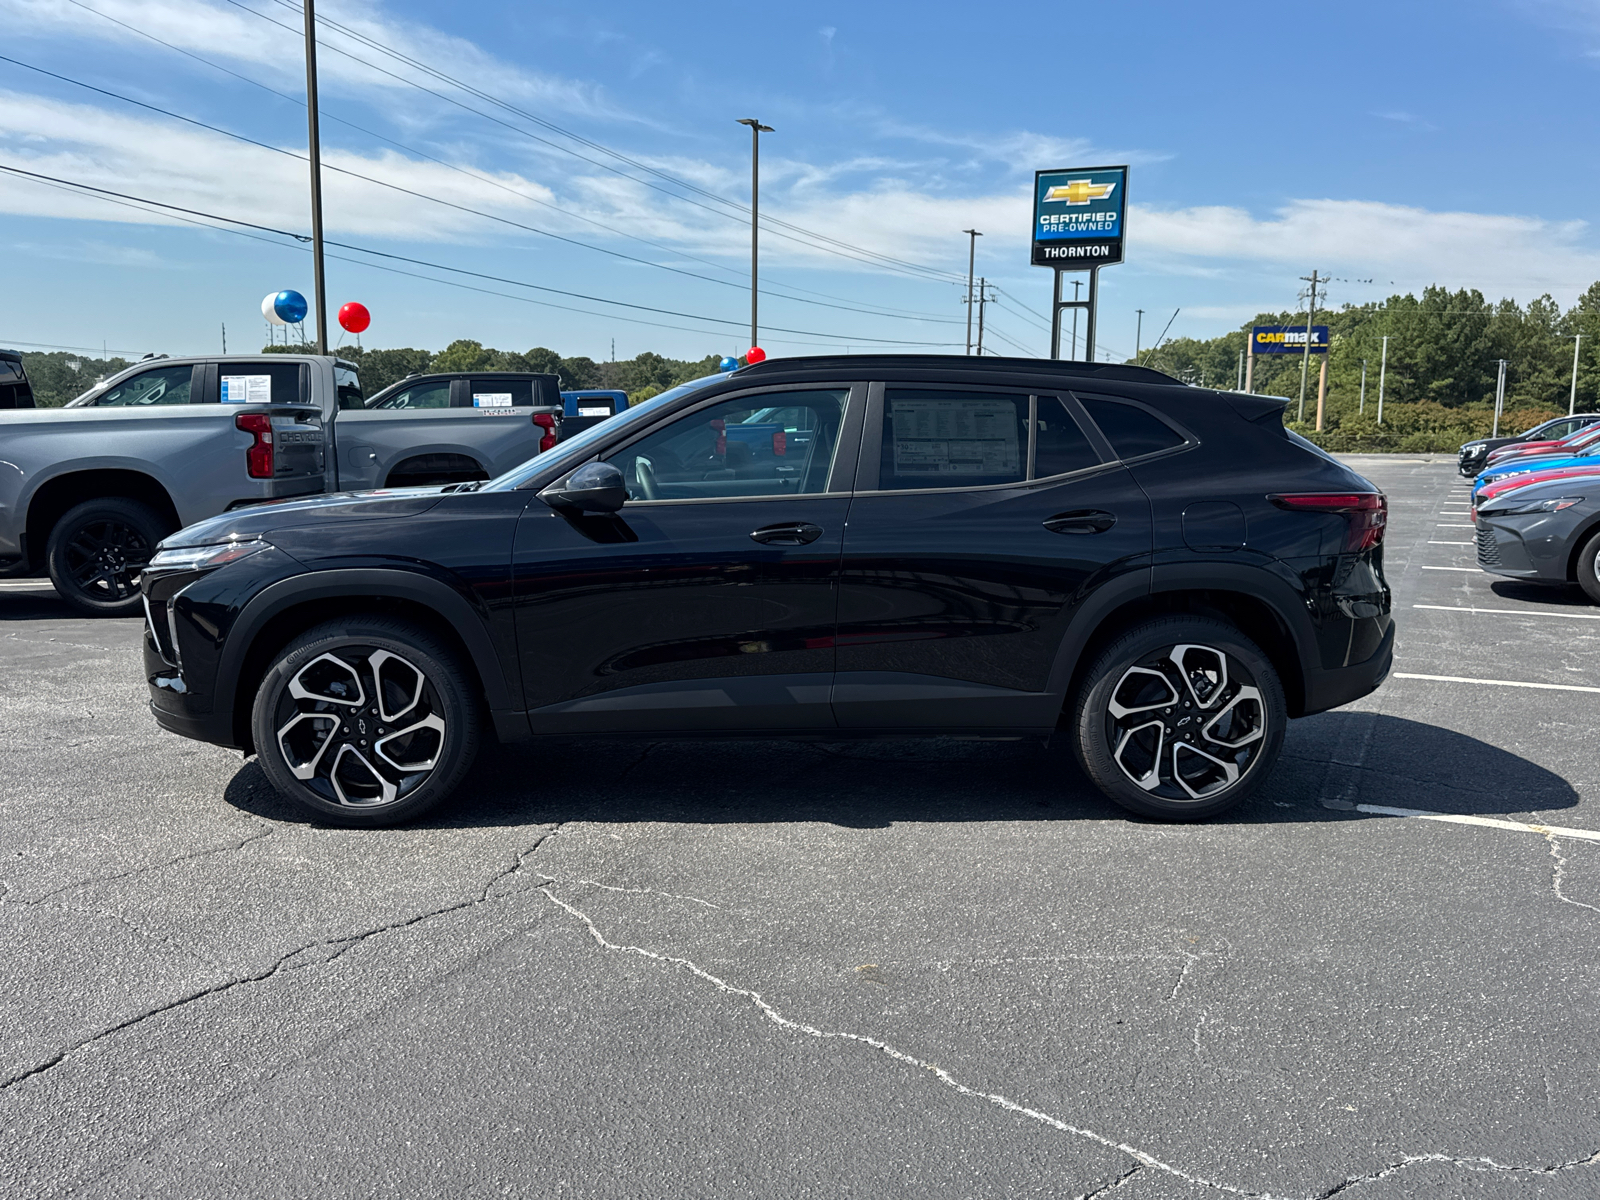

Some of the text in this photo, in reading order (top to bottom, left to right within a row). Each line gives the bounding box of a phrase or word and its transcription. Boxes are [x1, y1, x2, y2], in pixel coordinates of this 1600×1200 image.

[1040, 212, 1117, 225] CERTIFIED
[1043, 221, 1113, 233] PRE-OWNED
[1044, 245, 1110, 259] THORNTON
[1261, 669, 1282, 714] Continental
[1089, 731, 1111, 773] Continental
[393, 787, 436, 818] Continental
